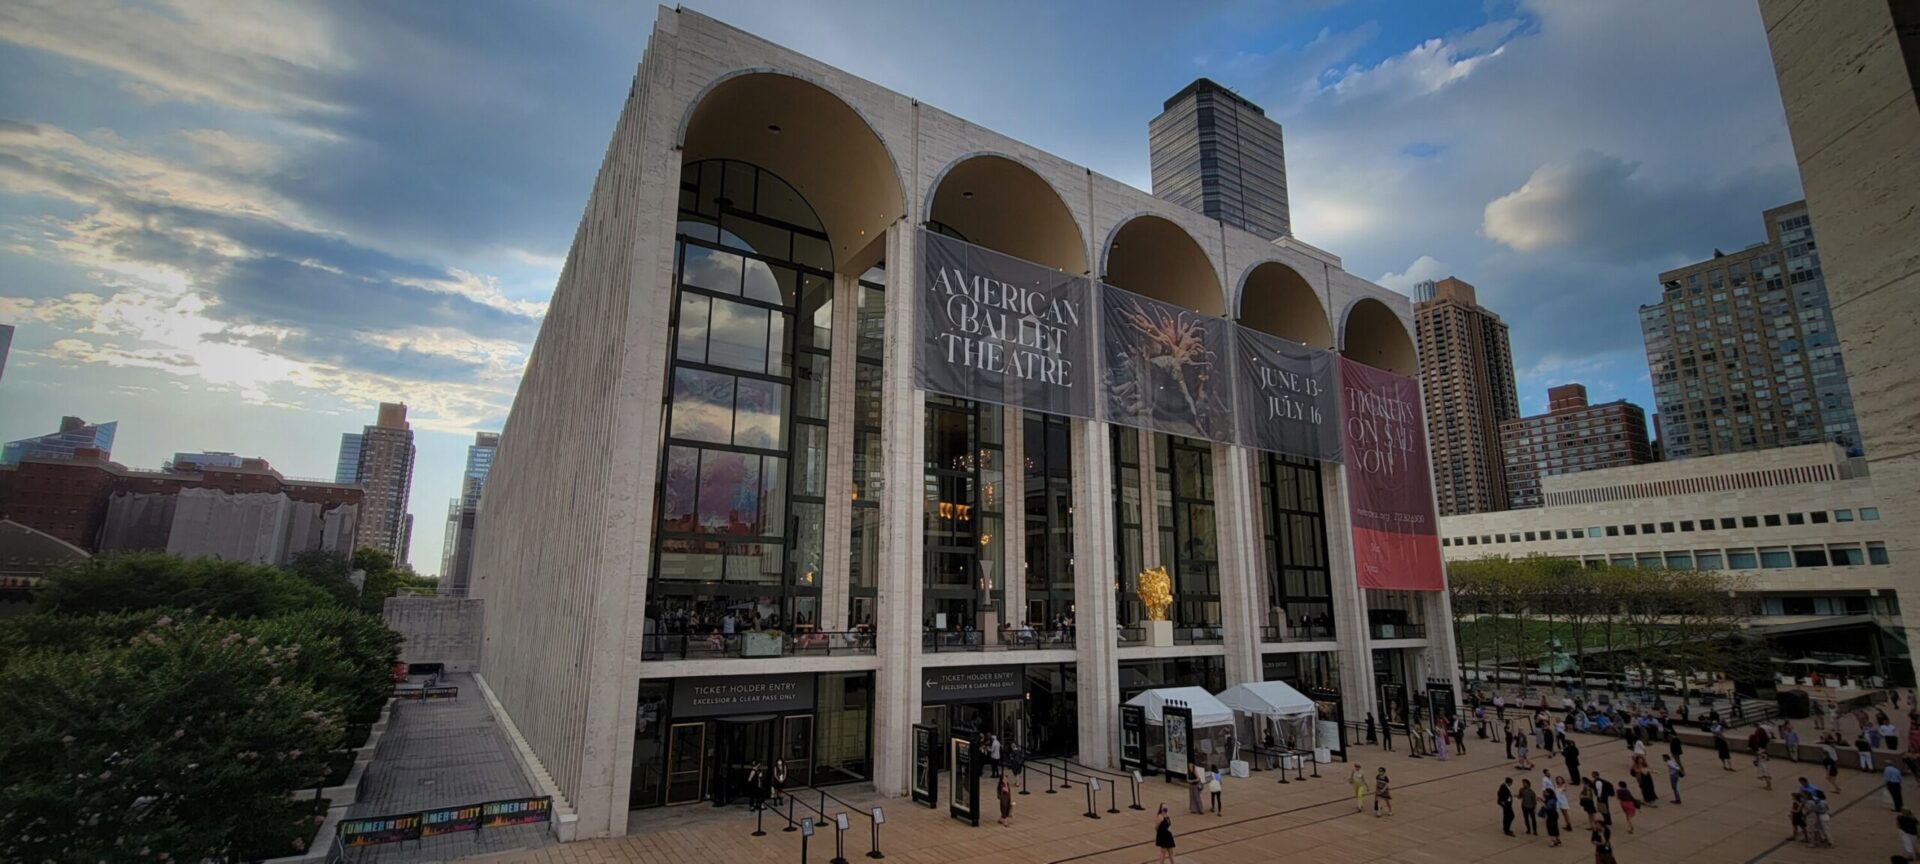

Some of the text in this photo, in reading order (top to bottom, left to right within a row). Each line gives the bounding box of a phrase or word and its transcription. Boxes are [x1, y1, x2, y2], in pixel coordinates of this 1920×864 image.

[930, 266, 1079, 327] AMERICAN
[947, 294, 1067, 354] BALLET
[941, 332, 1073, 388] THEATRE
[1261, 366, 1323, 397] JUNE 13-
[1269, 395, 1322, 425] JULY 16
[1345, 387, 1414, 425] TICKETS
[1348, 416, 1378, 443] ON
[1351, 445, 1395, 476] NOW
[694, 682, 796, 695] TICKET HOLDER ENTRY
[967, 673, 992, 681] HOLDER
[994, 672, 1014, 680] ENTRY
[693, 697, 730, 705] EXCELSIOR
[740, 695, 760, 703] CLEAR
[459, 806, 481, 819] CITY
[483, 802, 519, 815] SUMMER
[528, 799, 549, 811] CITY
[395, 816, 419, 829] CITY
